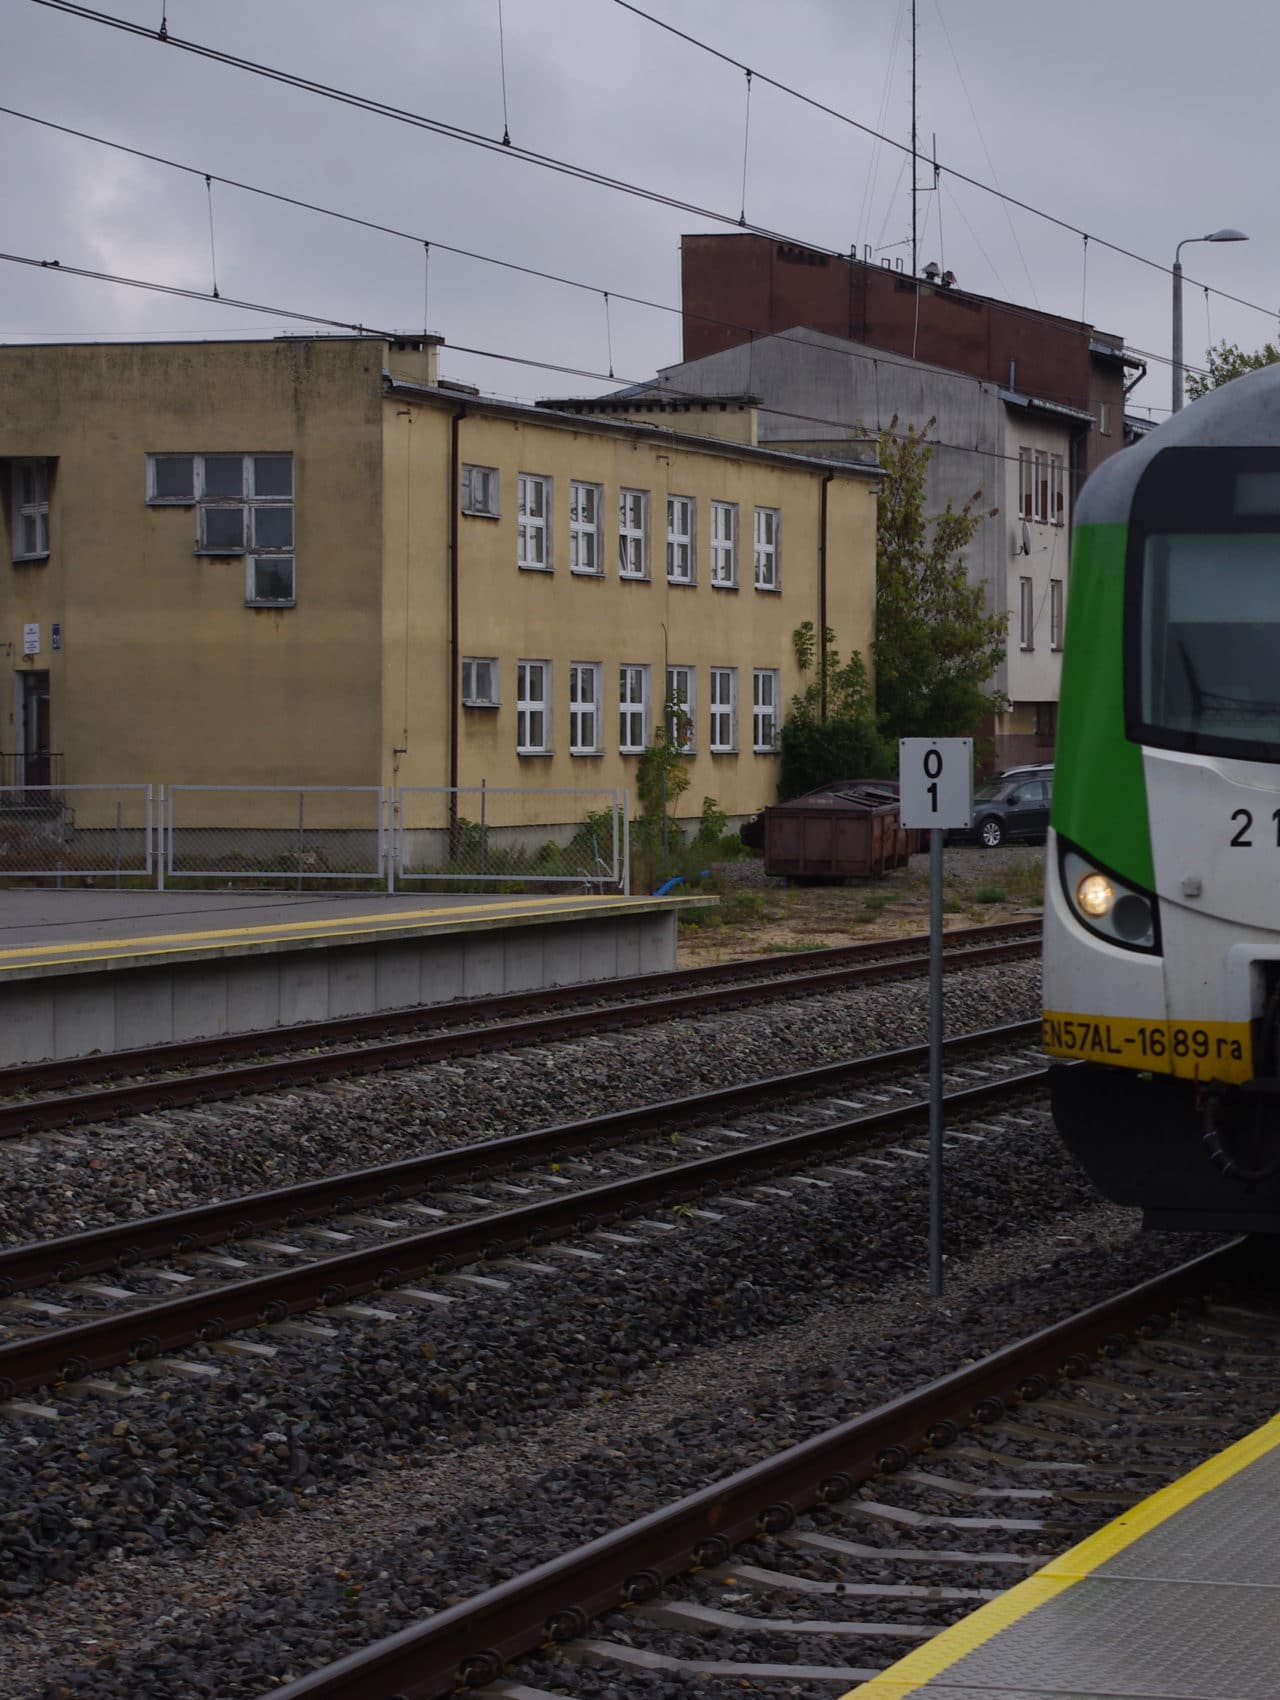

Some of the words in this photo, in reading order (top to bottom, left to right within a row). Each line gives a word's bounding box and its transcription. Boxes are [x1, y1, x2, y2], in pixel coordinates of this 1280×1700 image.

[924, 749, 943, 779] 0
[927, 782, 938, 813] 1
[1230, 808, 1253, 847] 2
[1216, 1037, 1243, 1060] ra
